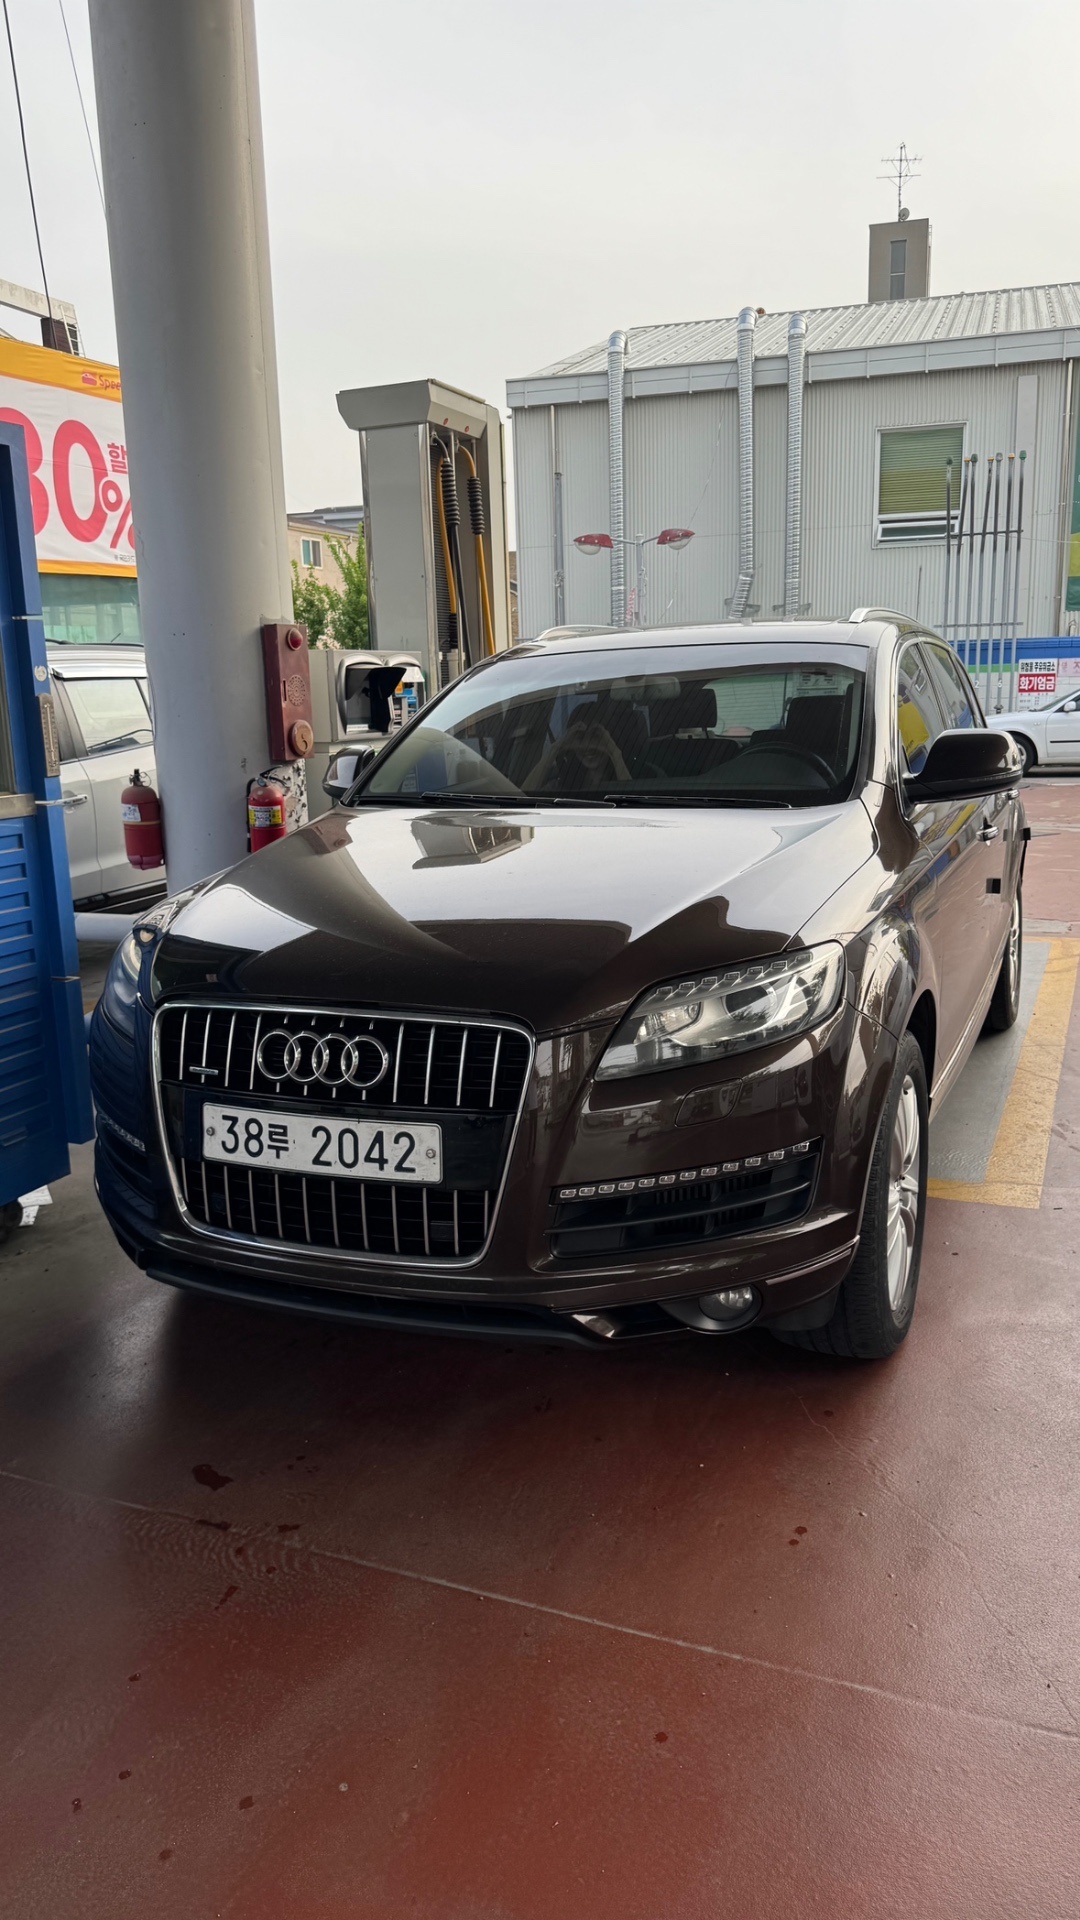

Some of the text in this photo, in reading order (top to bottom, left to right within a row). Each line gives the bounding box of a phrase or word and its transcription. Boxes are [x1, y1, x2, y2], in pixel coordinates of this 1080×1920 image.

[1019, 676, 1055, 690] 화기엄금
[221, 1114, 416, 1174] 38루 2042
